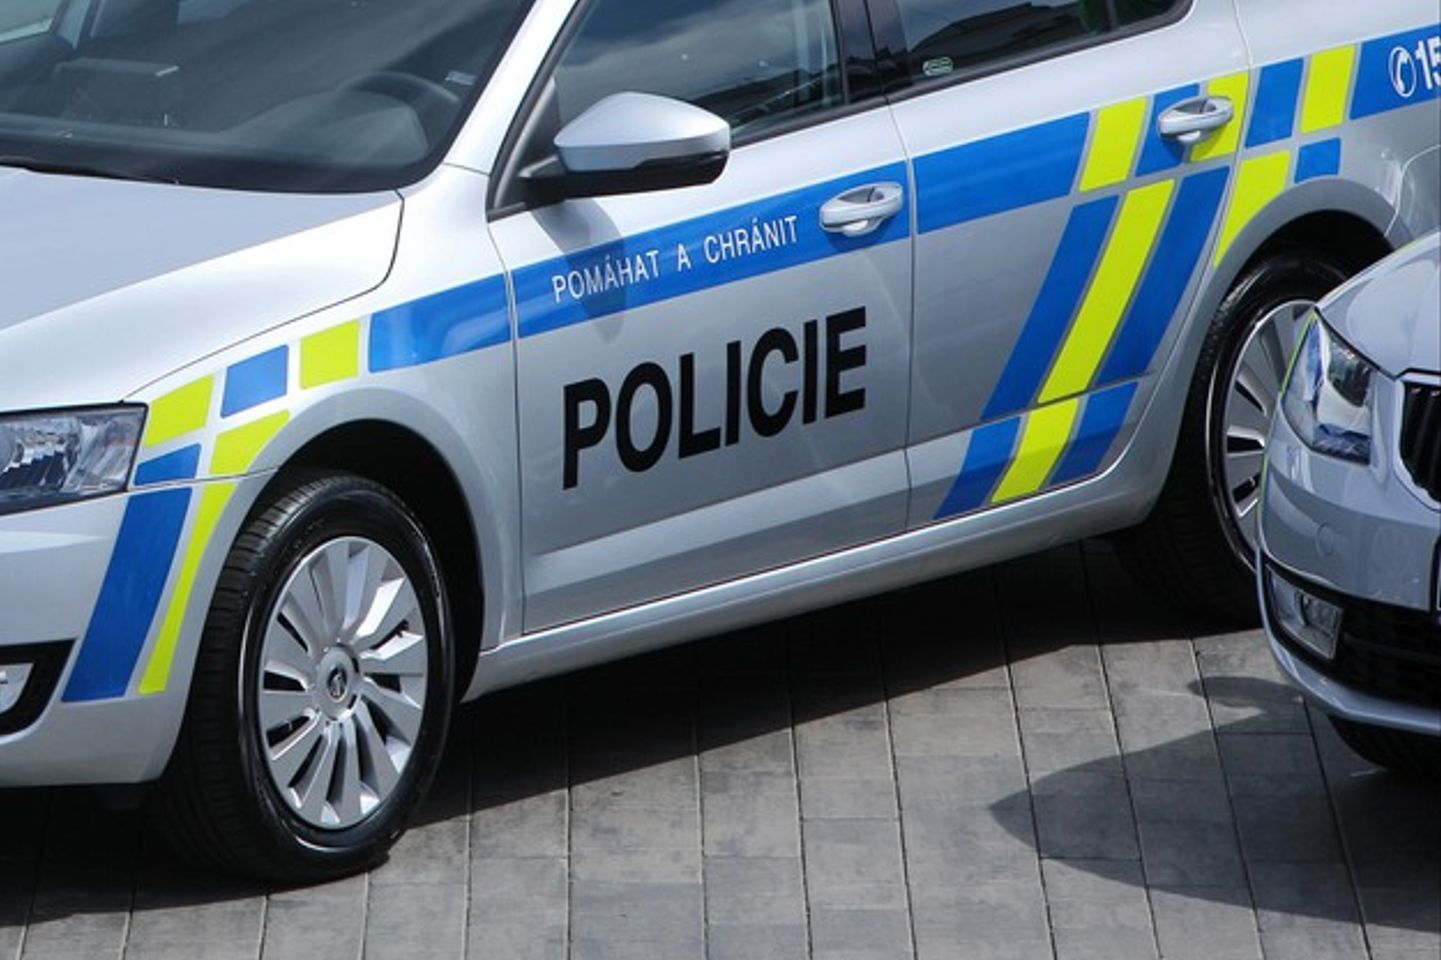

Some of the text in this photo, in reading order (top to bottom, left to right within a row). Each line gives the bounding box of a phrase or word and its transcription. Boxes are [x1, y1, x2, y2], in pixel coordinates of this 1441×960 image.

[551, 216, 798, 303] POMÁHAT A CHRÁNIT
[562, 306, 867, 491] POLICIE
